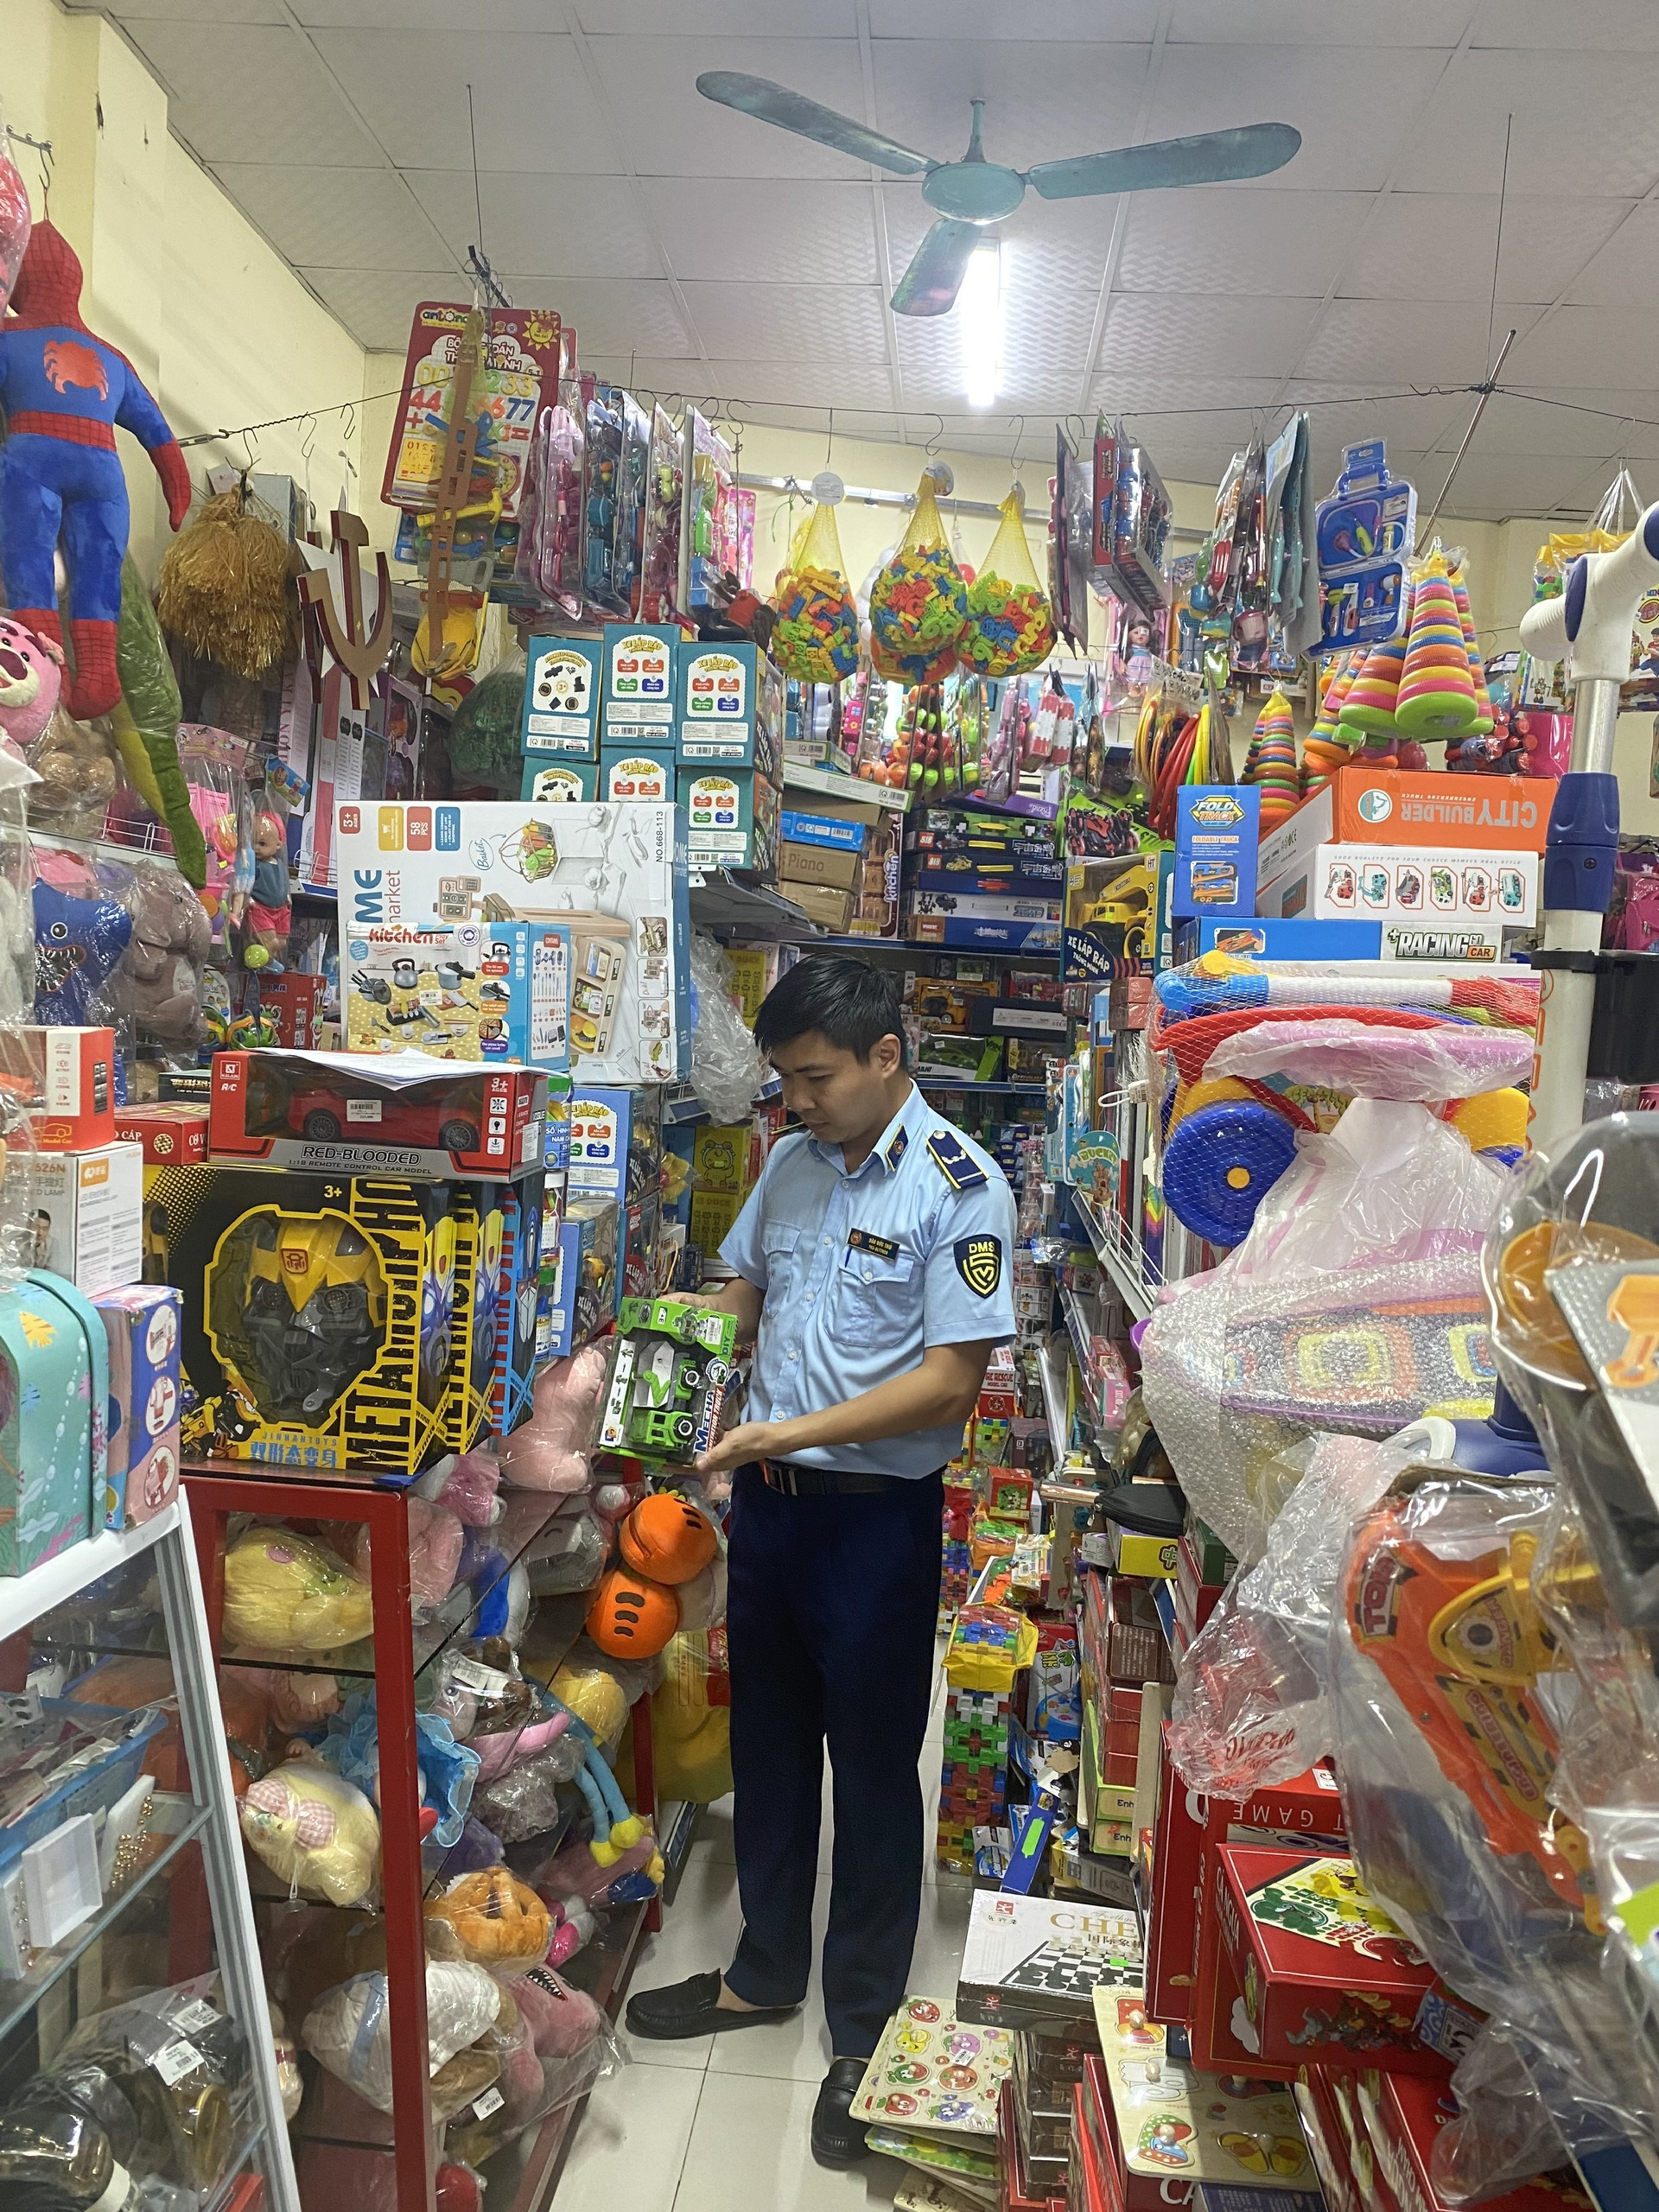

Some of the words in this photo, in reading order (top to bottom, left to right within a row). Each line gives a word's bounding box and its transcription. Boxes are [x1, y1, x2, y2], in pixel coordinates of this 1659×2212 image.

[1197, 801, 1234, 811] FOLD
[1199, 811, 1236, 821] TRACK
[1400, 803, 1475, 824] BUILDER
[1476, 798, 1538, 829] CITY
[343, 812, 353, 827] 3+
[410, 822, 421, 836] 58
[789, 852, 824, 872] Piano
[353, 869, 383, 923] ME
[1067, 935, 1077, 948] XE
[1077, 938, 1093, 959] LẮP
[1092, 950, 1110, 973] RÁP
[1397, 932, 1469, 957] RACING
[1471, 948, 1491, 957] CAR
[492, 1077, 508, 1089] 3+
[302, 1145, 421, 1166] RED-BLOODED
[324, 1185, 342, 1198] 3+
[968, 1241, 995, 1254] DMS
[721, 1338, 731, 1355] DIY
[995, 1373, 1014, 1382] RESCUE
[714, 1386, 725, 1415] TRUCK
[694, 1389, 715, 1453] MECHA
[1231, 1802, 1315, 1828] GAME
[1050, 1911, 1139, 1938] CHE
